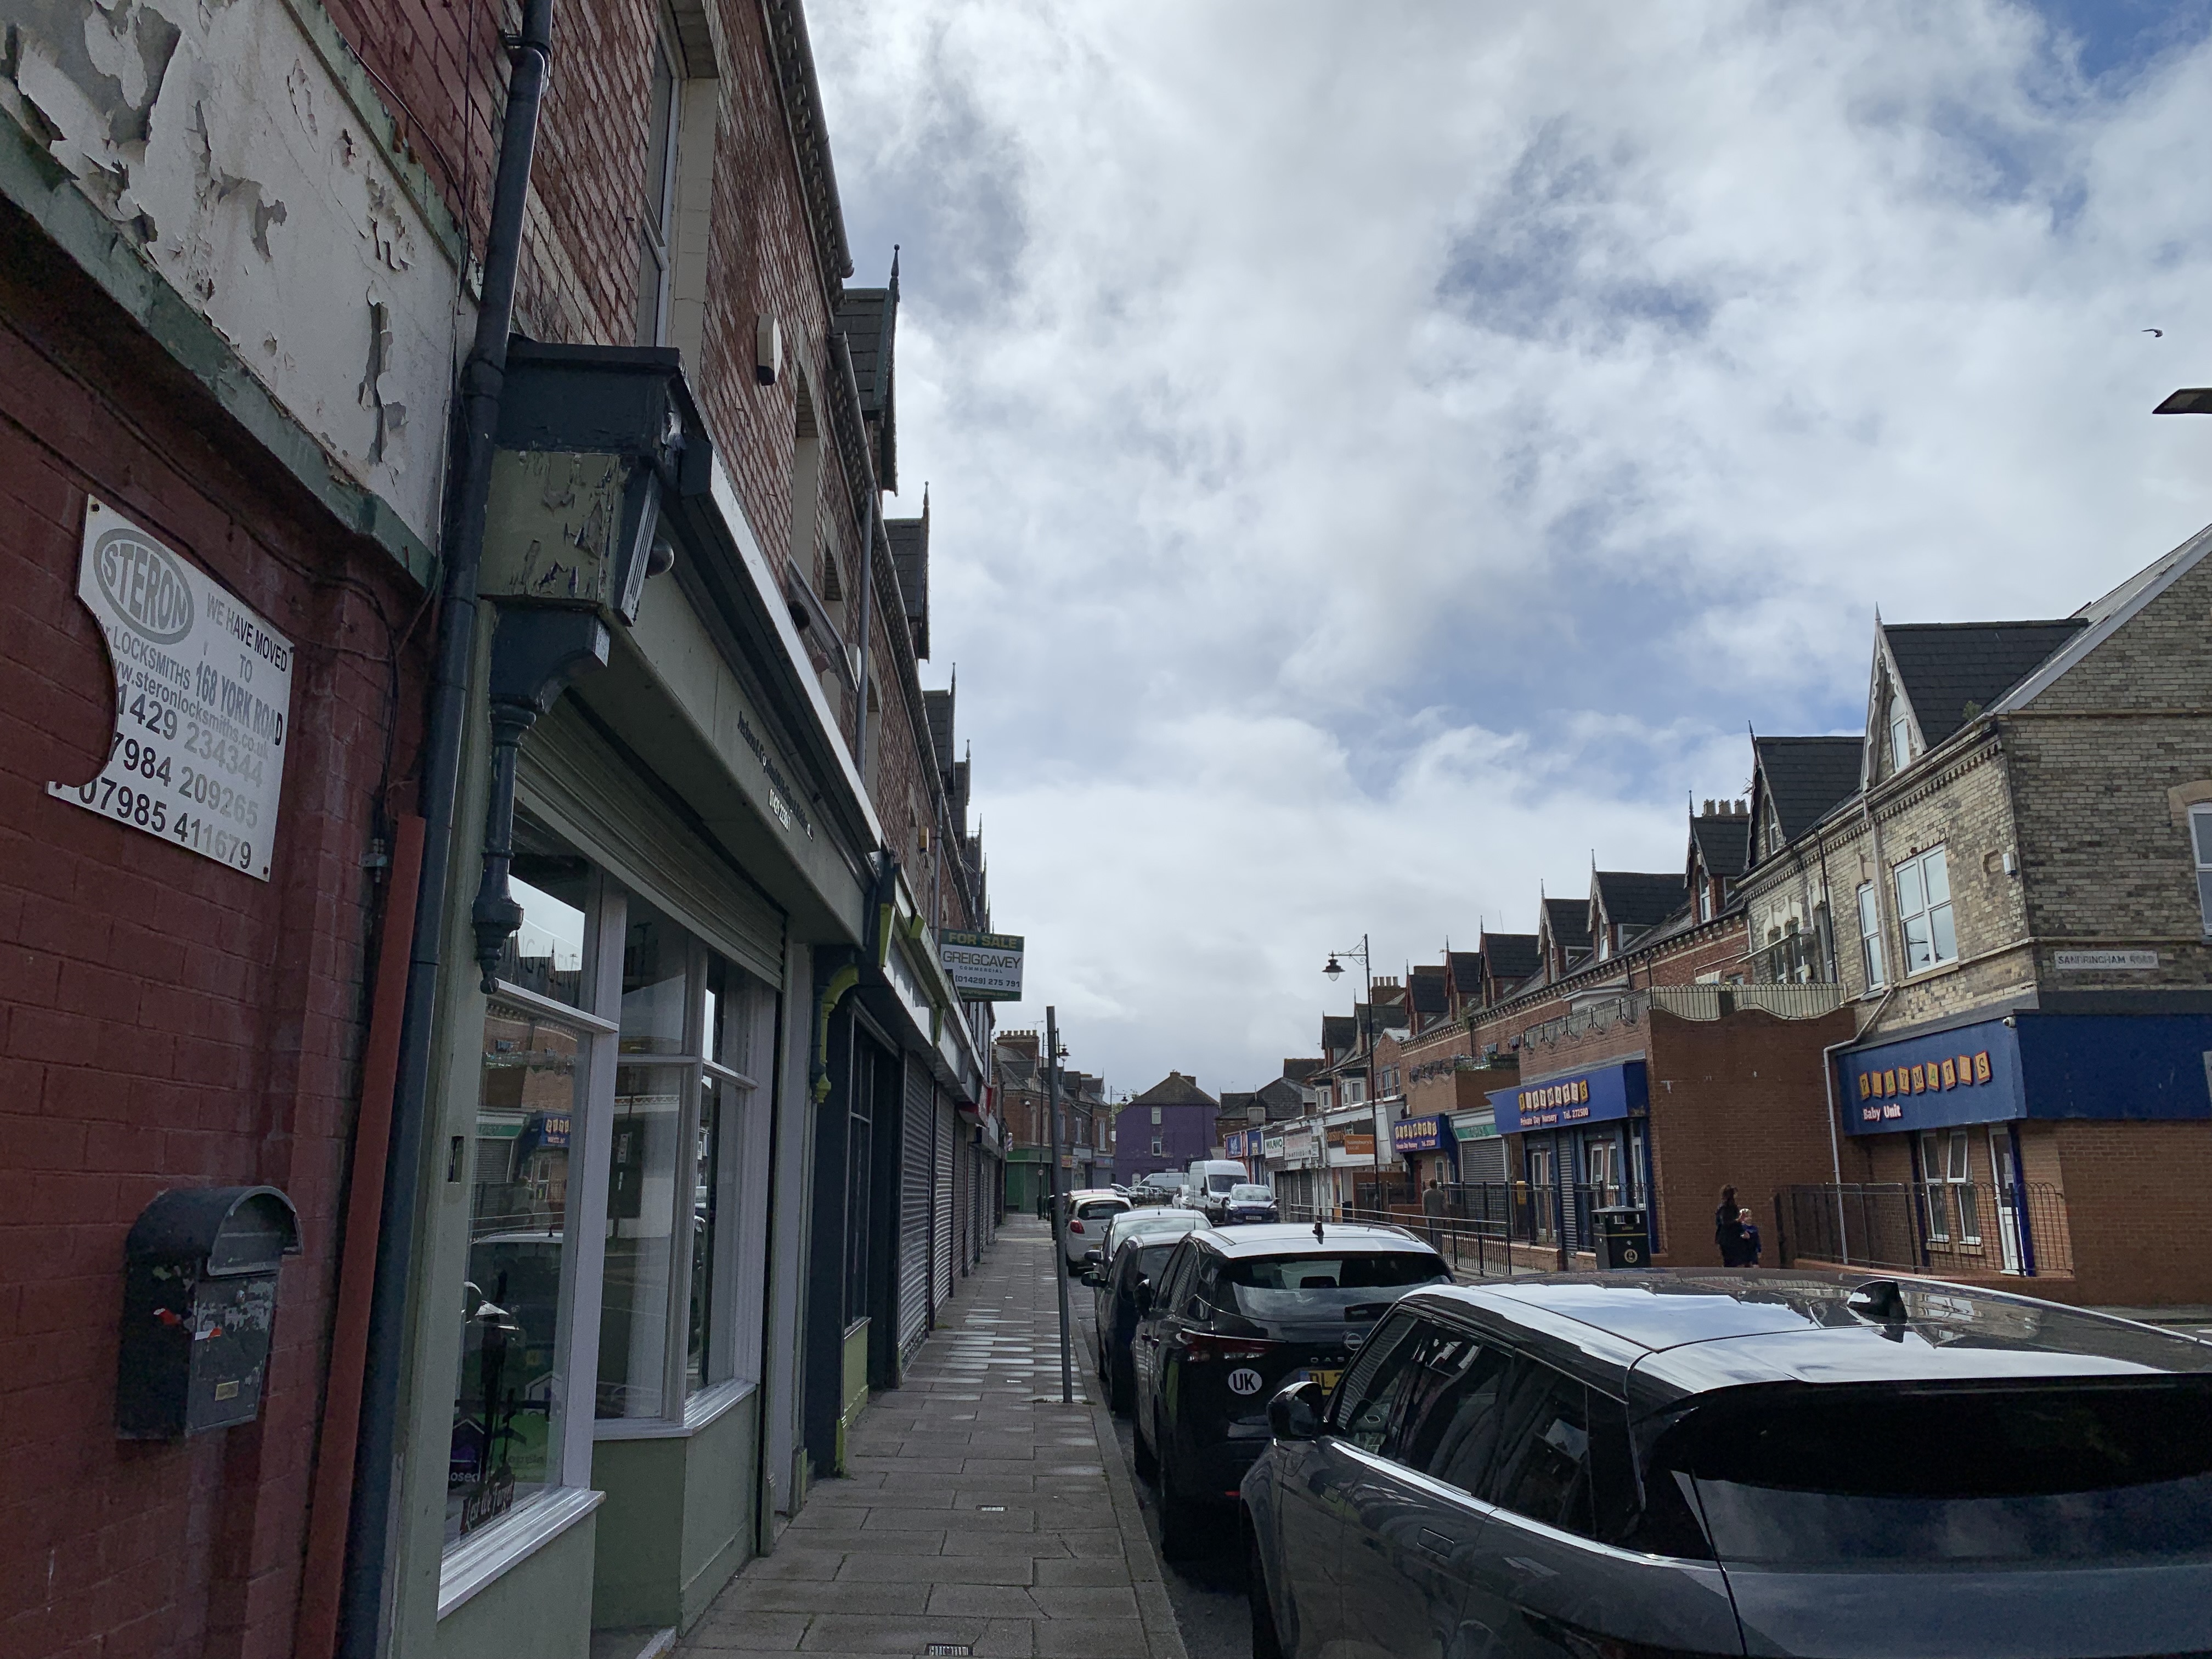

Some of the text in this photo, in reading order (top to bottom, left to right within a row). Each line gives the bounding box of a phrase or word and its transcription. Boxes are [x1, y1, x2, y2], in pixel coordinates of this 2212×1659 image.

[103, 543, 188, 630] STERON
[207, 592, 287, 673] WE HAVE MOVED
[113, 625, 191, 690] LOCKSMITHS
[240, 653, 253, 684] TO
[196, 661, 283, 746] 168 YORK ROAD
[184, 721, 263, 788] 234344
[178, 766, 258, 829] 209265
[78, 776, 252, 870] 07985 411679
[949, 932, 1017, 949] FOR SALE
[959, 966, 1003, 974] COMMERCIAL
[2058, 955, 2126, 964] SANDRINGHAM
[955, 975, 986, 985] (01429)
[1860, 1051, 1990, 1096] PAYMATES
[1519, 1081, 1588, 1111] PLAYMATES
[1542, 1114, 1557, 1124] Nursery
[1572, 1107, 1589, 1118] 272500
[1863, 1103, 1901, 1121] Baby Unit
[1233, 1373, 1256, 1391] UK
